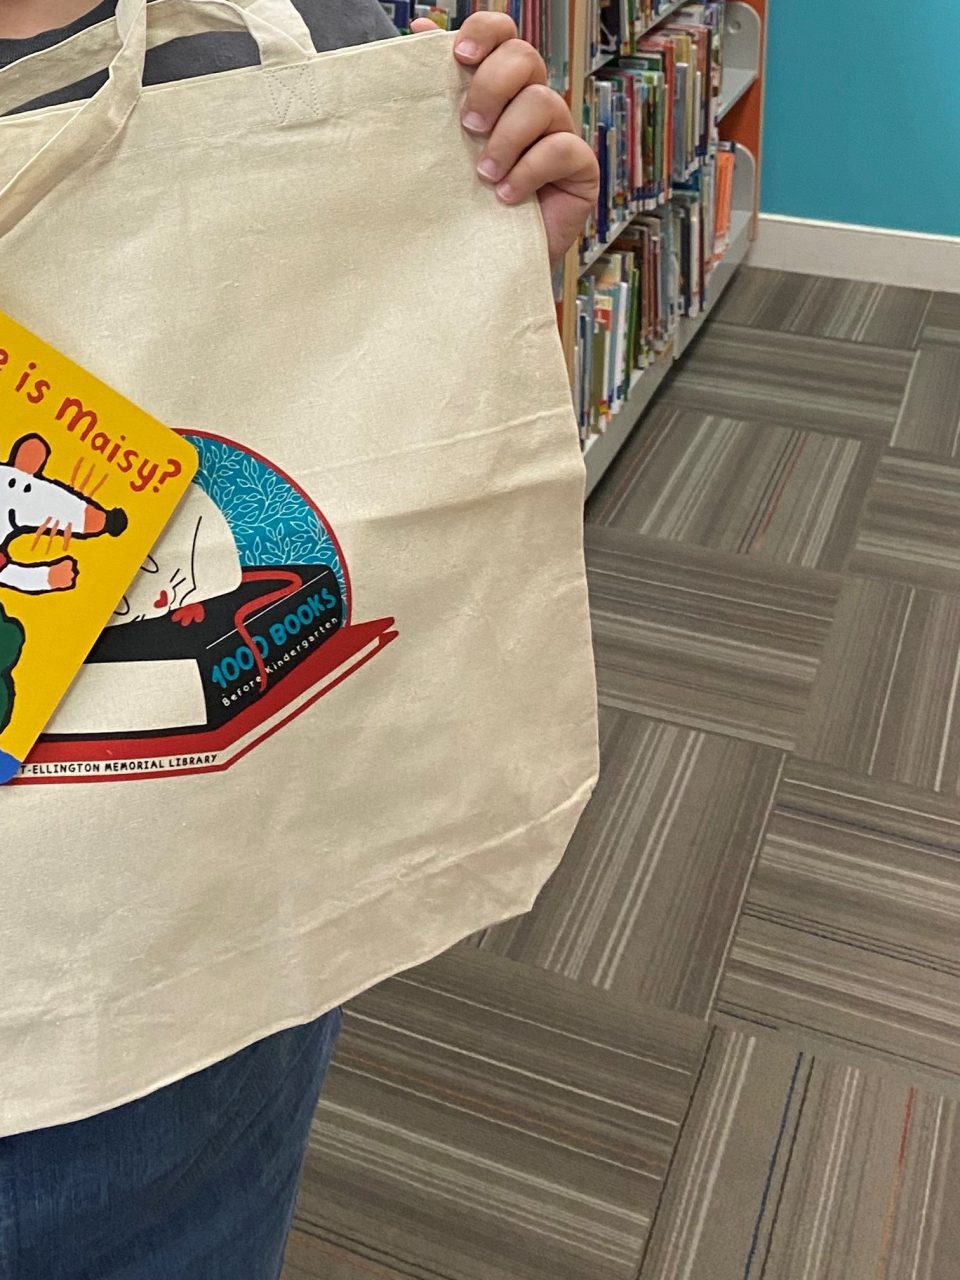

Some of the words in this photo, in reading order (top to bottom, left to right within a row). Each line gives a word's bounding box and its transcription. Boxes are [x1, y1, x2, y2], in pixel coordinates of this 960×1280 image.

[14, 363, 53, 406] is
[55, 394, 183, 498] Maisy?
[211, 634, 270, 690] 1000
[268, 587, 338, 646] BOOKS
[221, 675, 262, 707] Before
[264, 616, 338, 675] Kindergarten
[20, 761, 101, 776] T-ELLINGTON
[103, 759, 166, 773] MEMORIAL
[168, 753, 218, 769] LIBRARY
